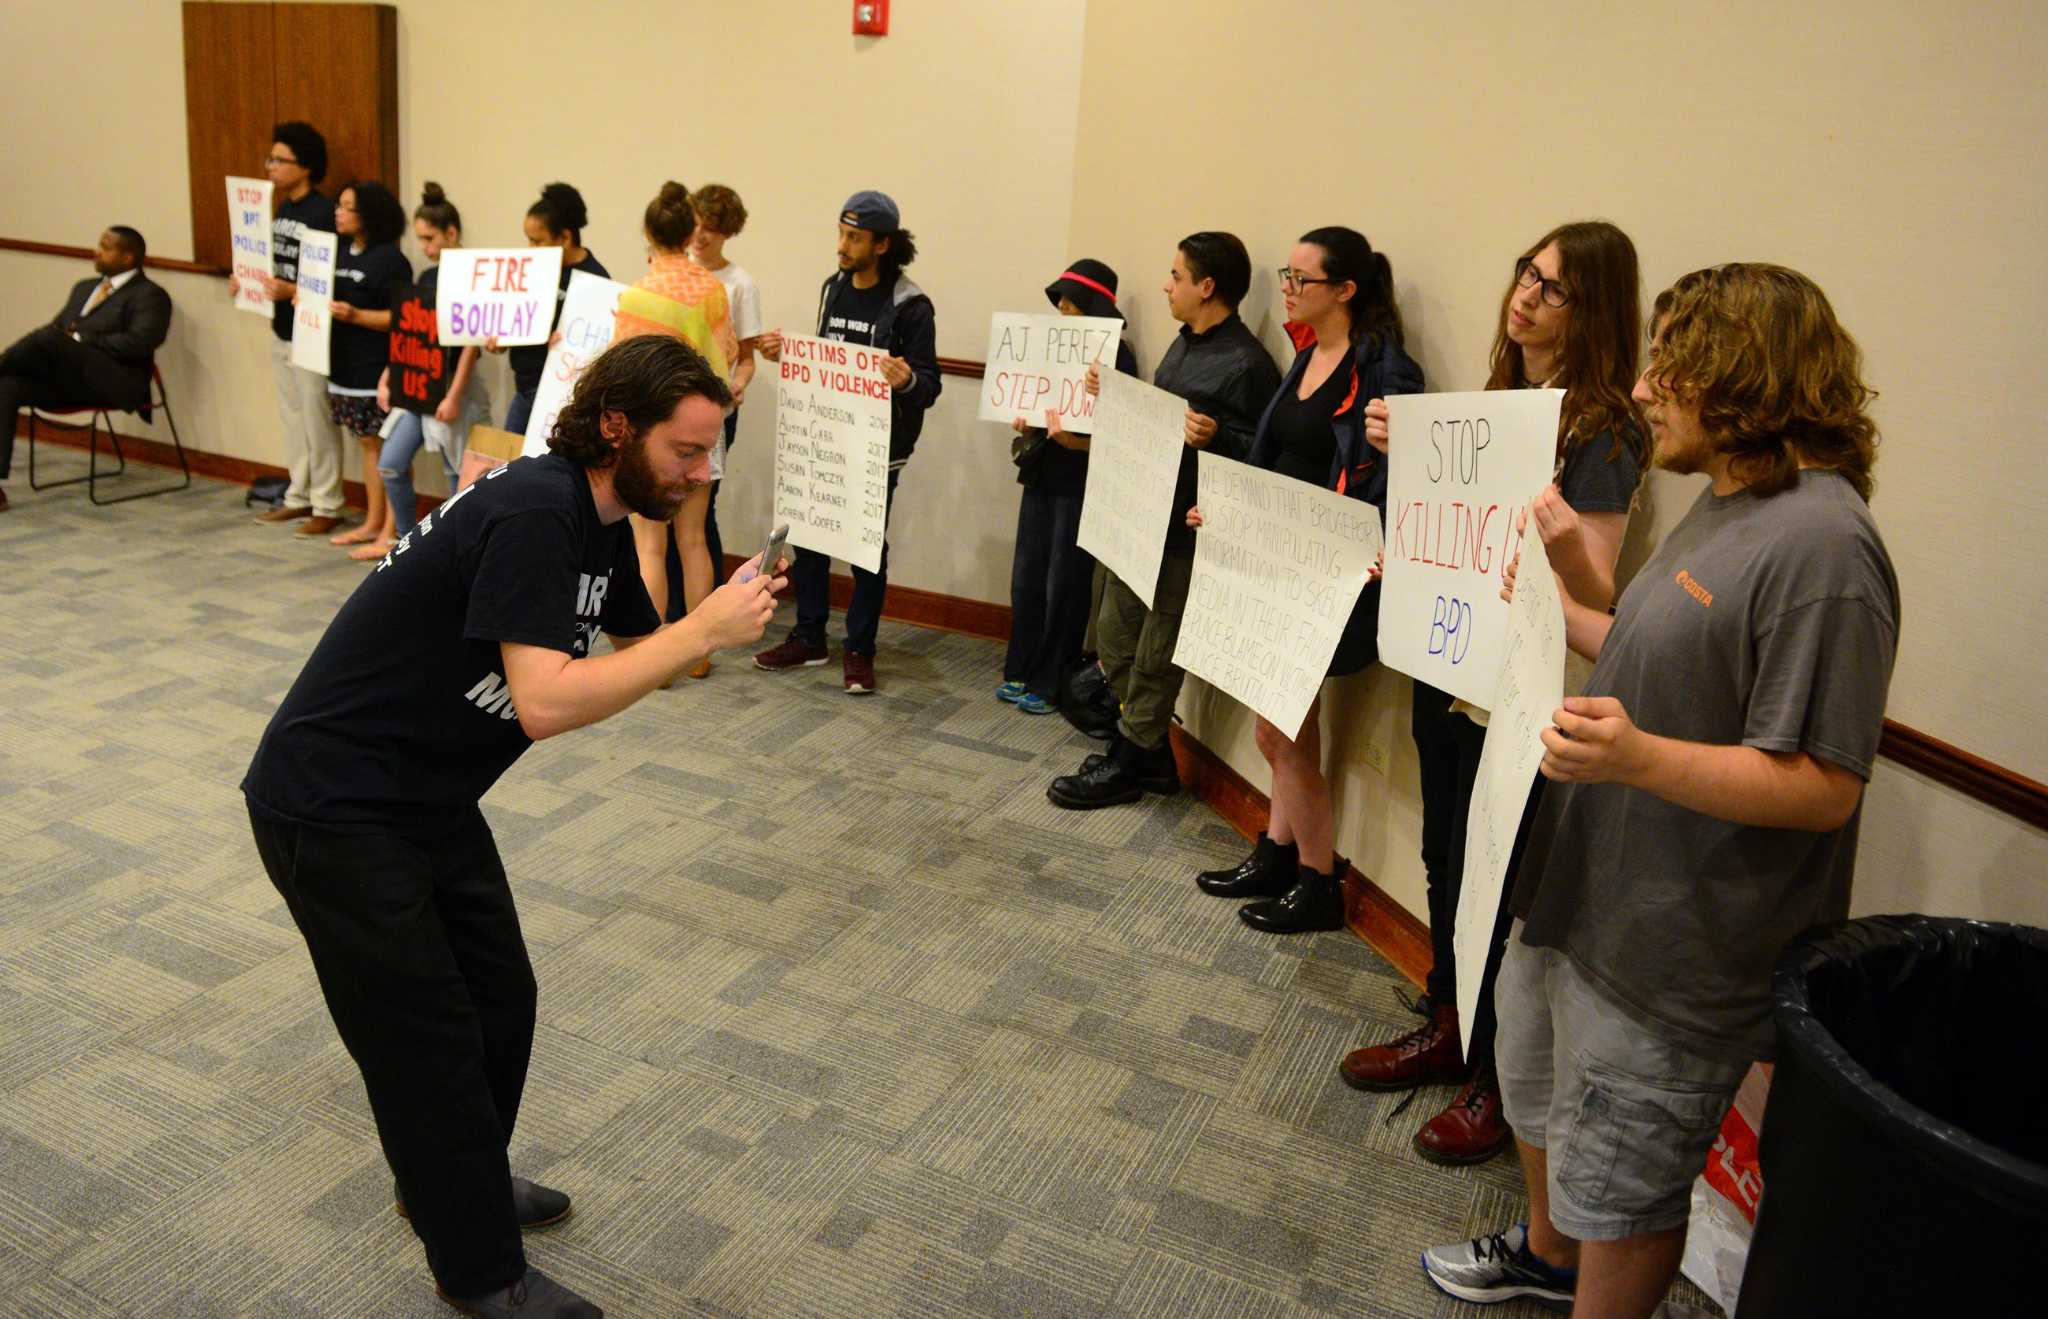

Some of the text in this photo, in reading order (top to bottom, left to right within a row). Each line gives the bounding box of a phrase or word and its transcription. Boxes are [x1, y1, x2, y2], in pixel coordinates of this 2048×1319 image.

[472, 256, 533, 293] FIRE
[450, 299, 538, 338] BOULAY
[781, 335, 881, 373] VICTIMS OF
[1046, 326, 1111, 368] PEREZ
[780, 360, 889, 401] BPD VIOLENCE
[990, 371, 1098, 418] STEP DOW
[1426, 417, 1491, 485] STOP
[1394, 498, 1498, 575] KILLING
[1428, 594, 1472, 665] BPD
